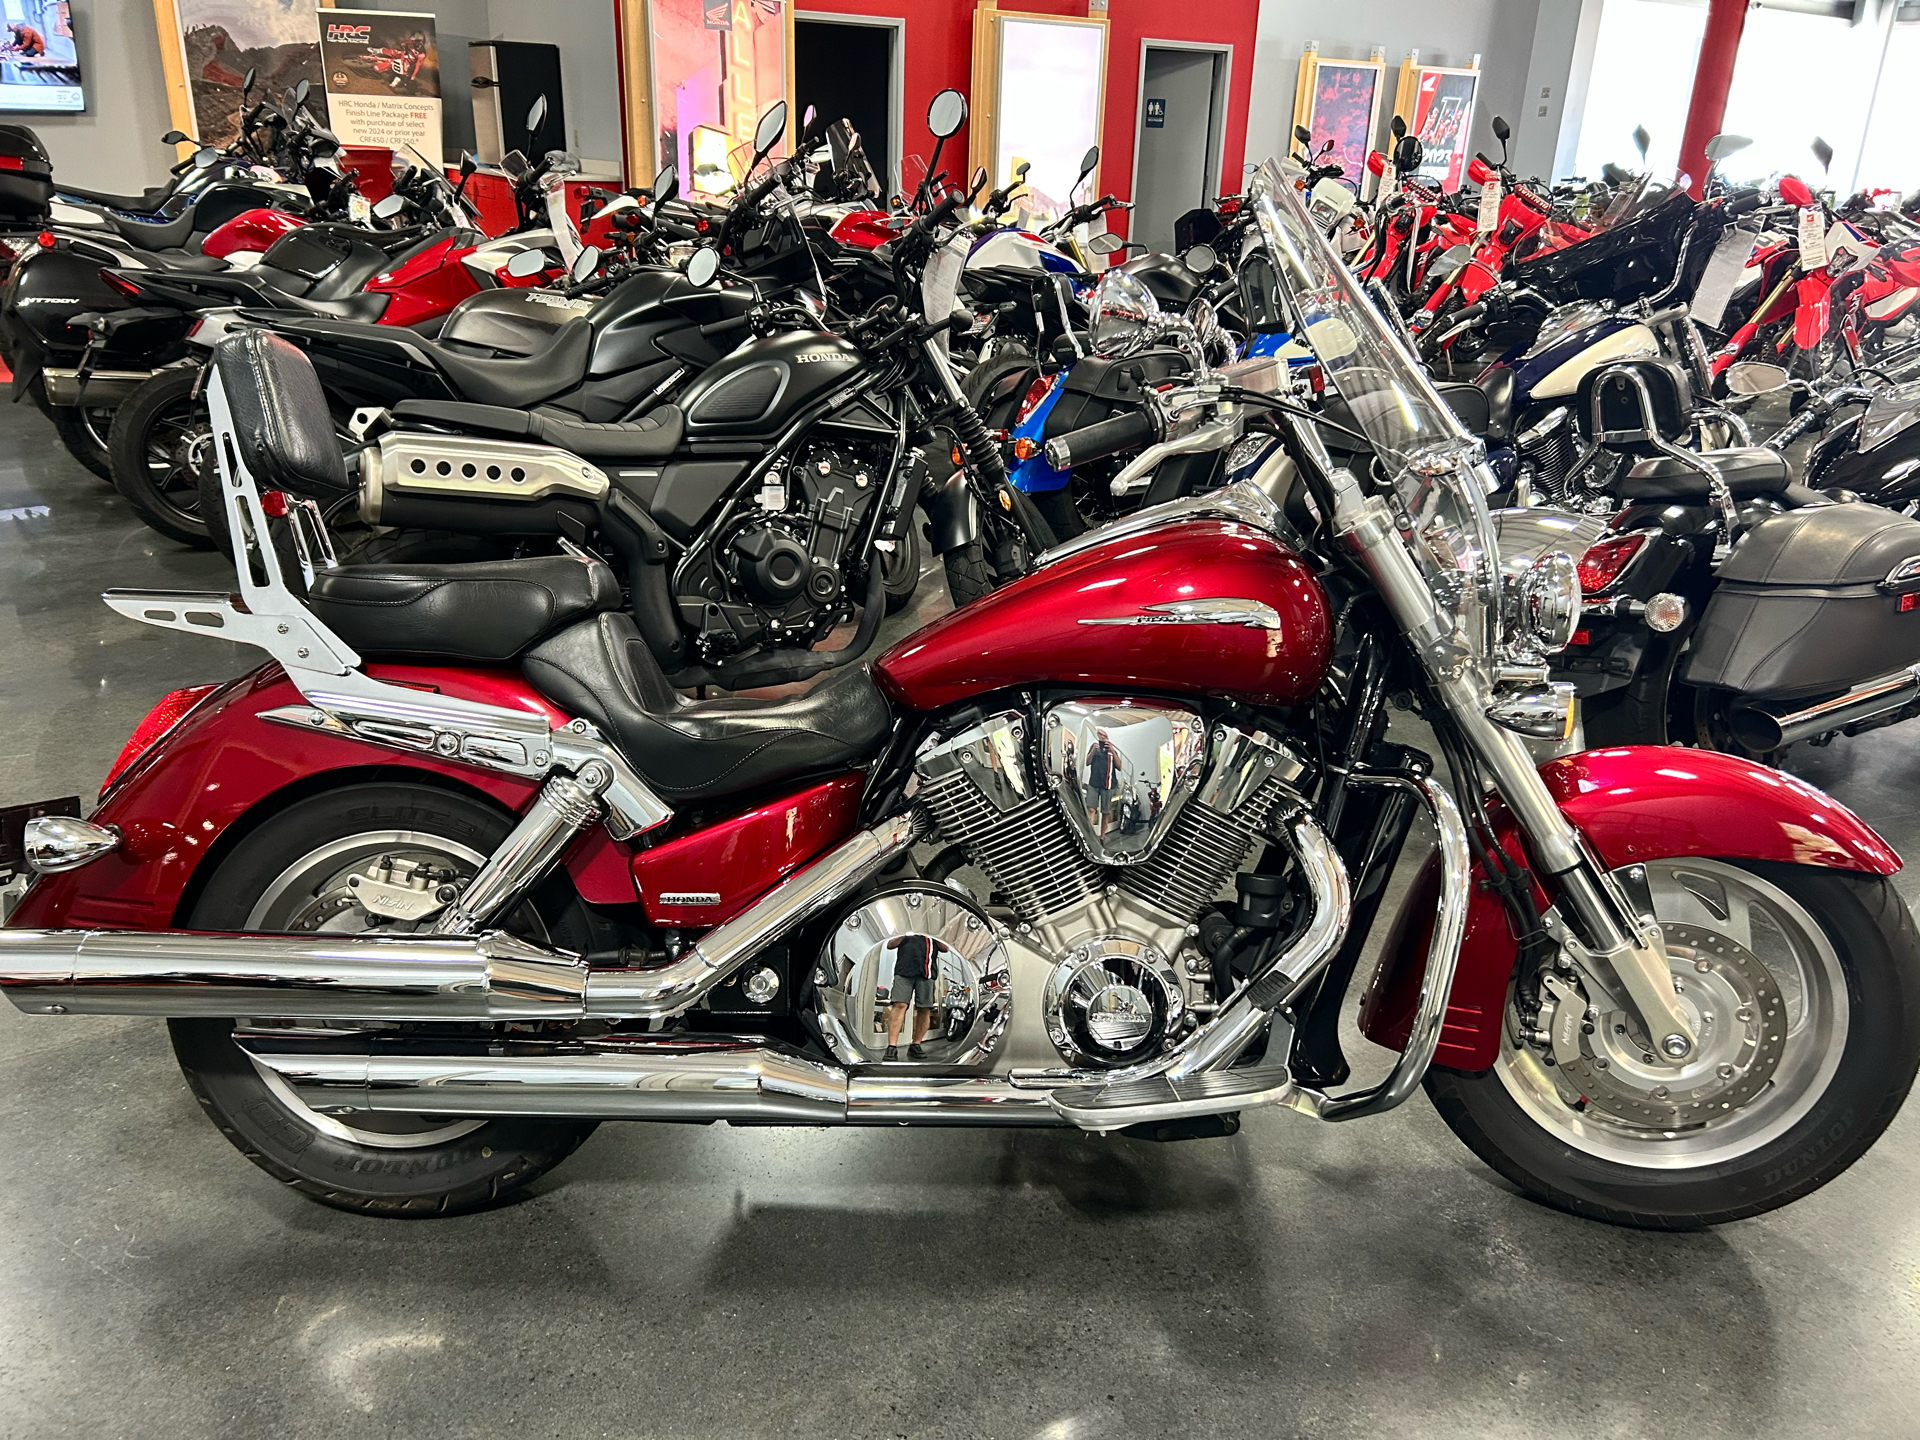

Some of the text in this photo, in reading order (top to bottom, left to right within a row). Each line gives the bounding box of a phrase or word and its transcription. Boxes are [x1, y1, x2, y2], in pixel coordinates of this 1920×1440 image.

[327, 24, 371, 40] HRC
[404, 103, 434, 111] Concepts
[381, 111, 409, 119] Package
[795, 353, 853, 363] HONDA
[348, 806, 451, 827] ELITE
